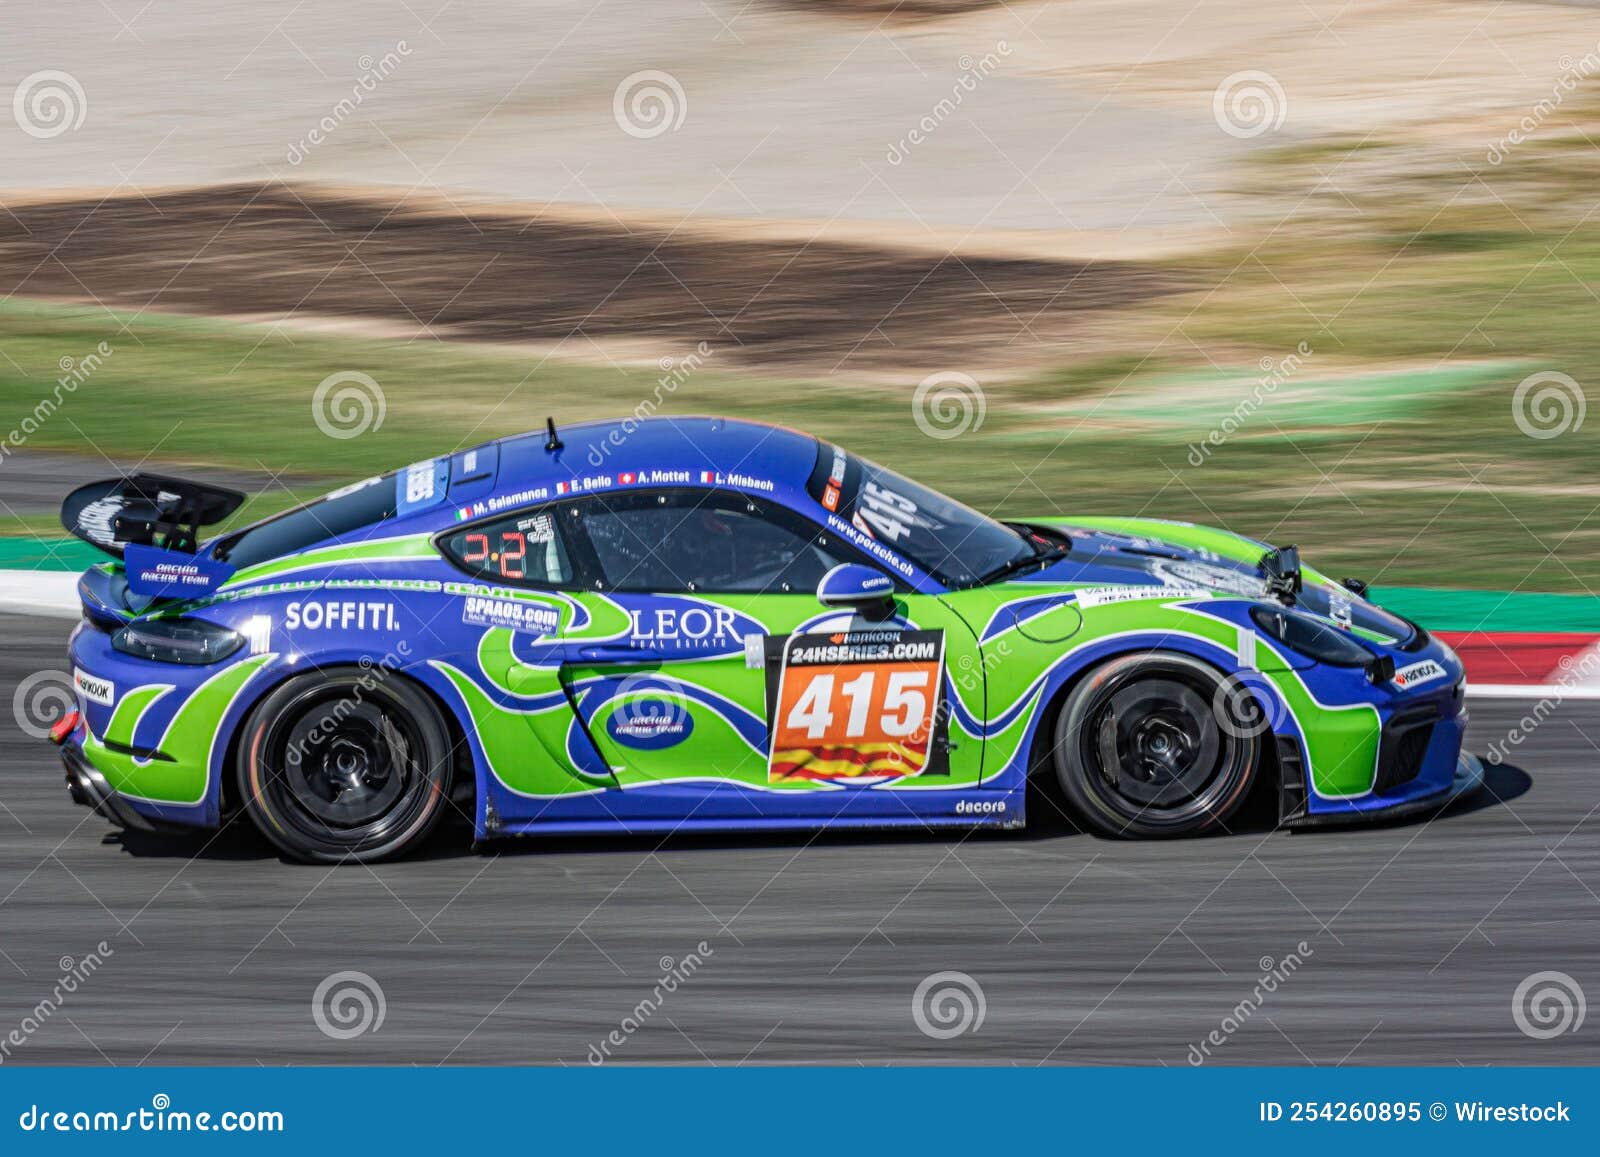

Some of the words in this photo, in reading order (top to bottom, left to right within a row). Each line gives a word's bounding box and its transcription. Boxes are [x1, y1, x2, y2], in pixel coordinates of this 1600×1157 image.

[571, 479, 582, 492] E.
[638, 471, 650, 484] A.
[652, 470, 690, 483] Mottet
[715, 472, 726, 485] L.
[728, 474, 774, 492] Misbach
[473, 502, 488, 516] M.
[488, 488, 548, 511] Salamanca
[859, 481, 918, 542] 415
[828, 515, 914, 577] www.porsche.ch
[285, 601, 394, 631] SOFFITI
[630, 608, 744, 645] LEOR
[630, 639, 665, 649] REAL
[676, 638, 726, 649] ESTATE
[791, 642, 935, 664] 24HSERIES.COM
[786, 671, 930, 740] 415
[955, 800, 1006, 813] decora
